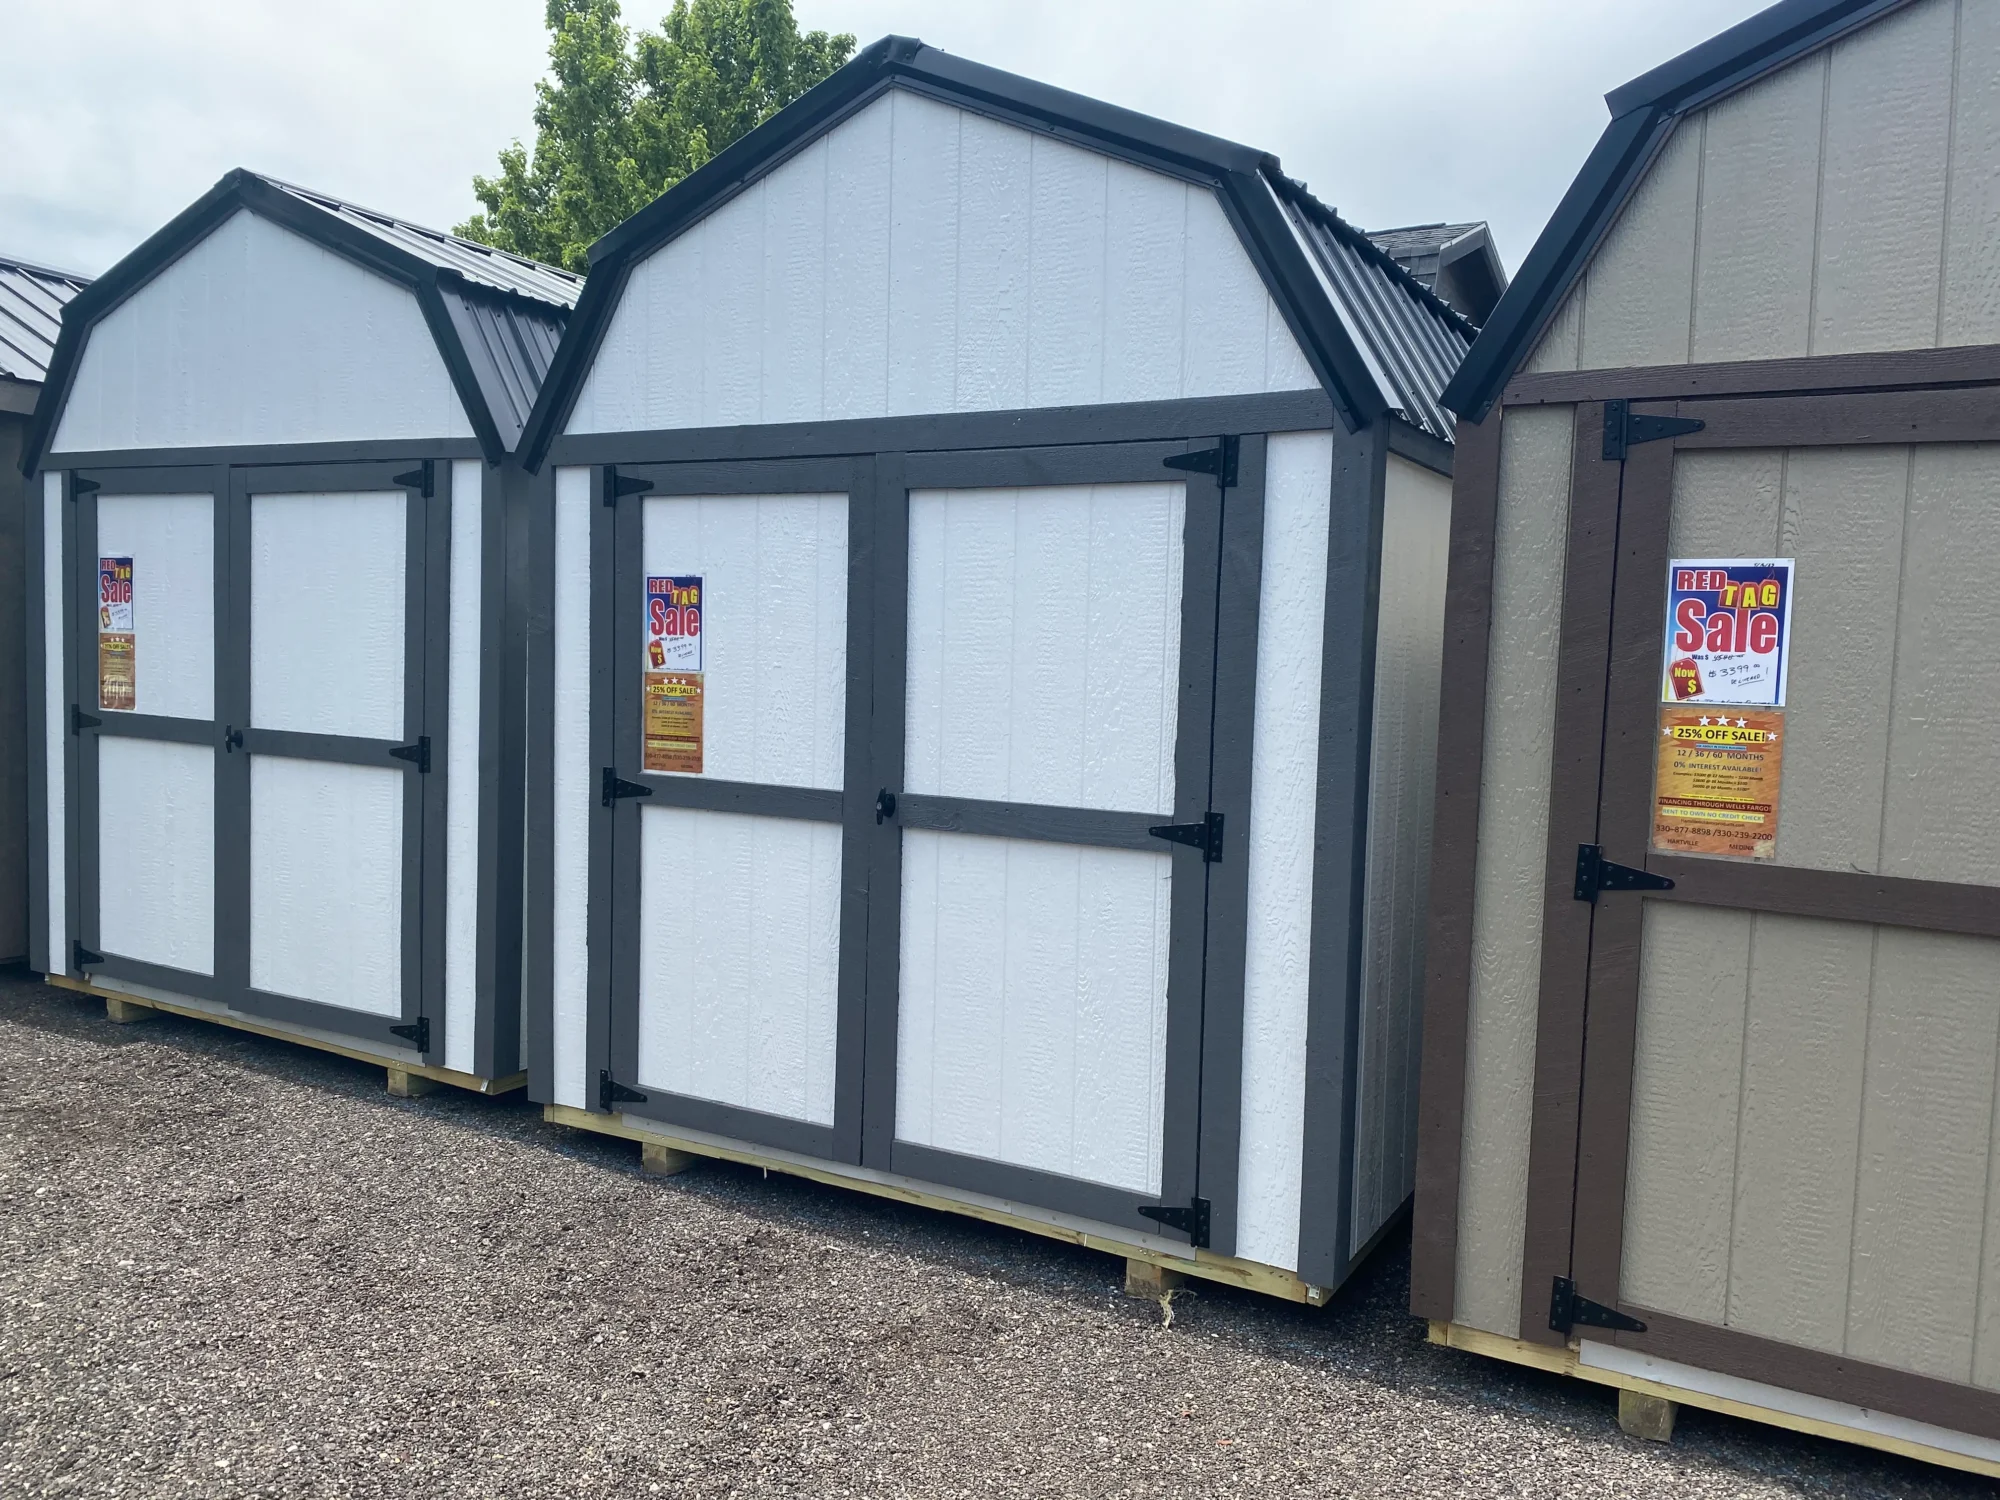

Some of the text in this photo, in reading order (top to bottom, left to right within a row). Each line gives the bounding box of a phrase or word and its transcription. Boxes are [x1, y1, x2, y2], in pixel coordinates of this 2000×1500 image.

[101, 560, 130, 578] RED TAG
[101, 574, 131, 604] Sale
[649, 579, 698, 605] RED TAG
[1677, 570, 1777, 607] RED TAG
[650, 598, 699, 636] Sale
[1675, 598, 1778, 654] Sale
[658, 654, 662, 664] $
[1674, 667, 1696, 678] Now
[1720, 665, 1749, 677] 3399
[1688, 679, 1697, 694] $
[1678, 728, 1765, 742] 25% OFF SALE!
